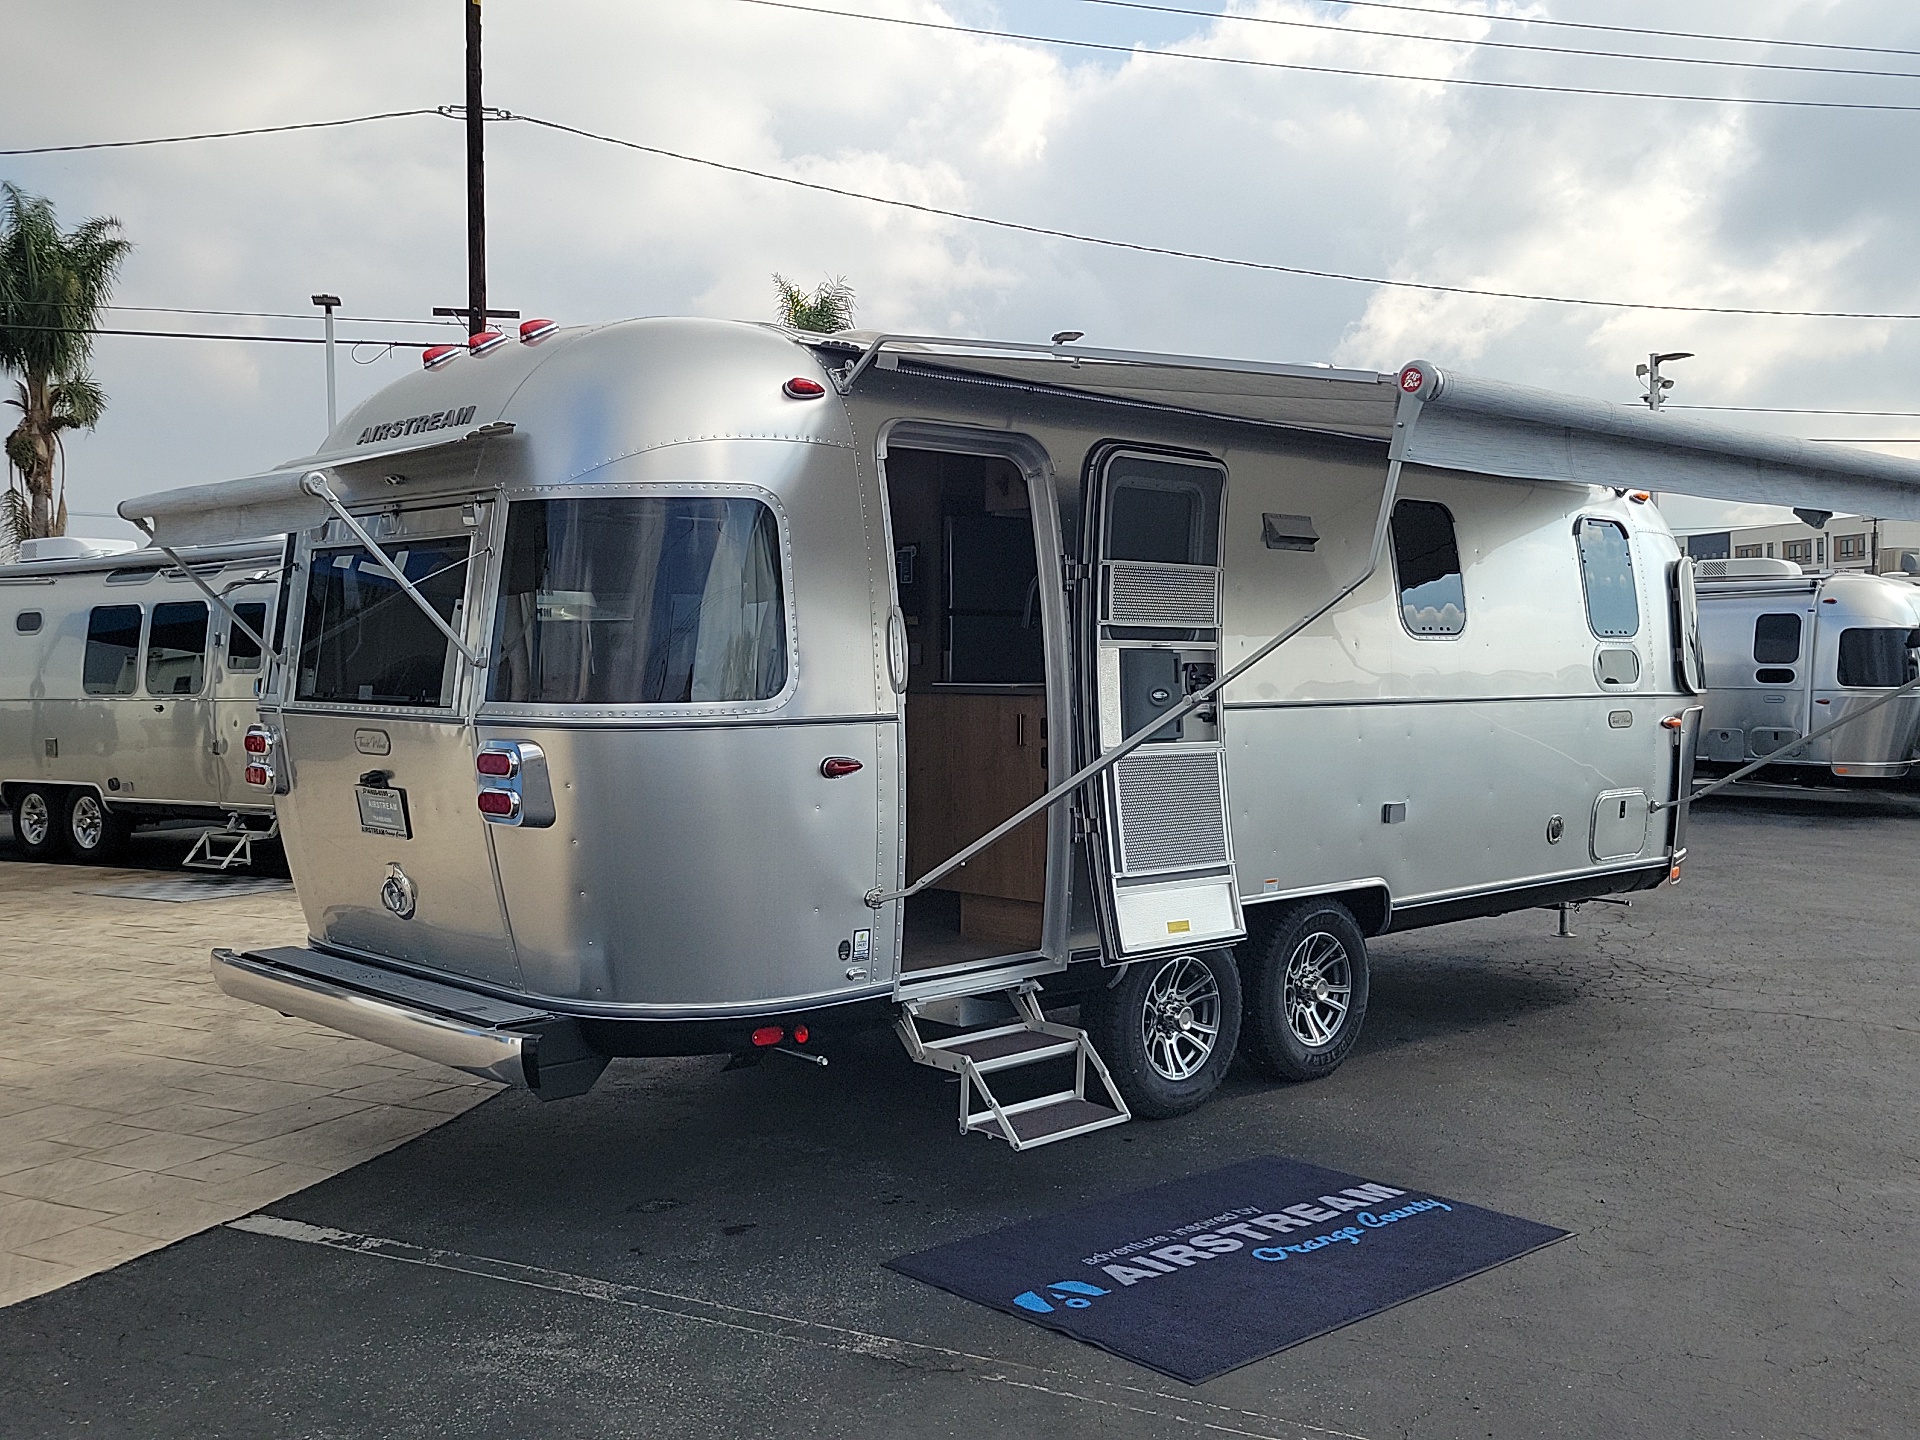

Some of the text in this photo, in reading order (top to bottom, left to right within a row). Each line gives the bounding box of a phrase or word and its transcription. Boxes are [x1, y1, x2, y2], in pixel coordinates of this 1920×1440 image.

[1403, 379, 1420, 388] Dee
[1405, 371, 1421, 381] Zip
[356, 405, 477, 445] AIRSTREAM
[1101, 1182, 1408, 1287] AIRSTREAM
[1168, 1210, 1239, 1236] inspired
[1231, 1205, 1263, 1216] by
[1252, 1198, 1453, 1262] Orange County
